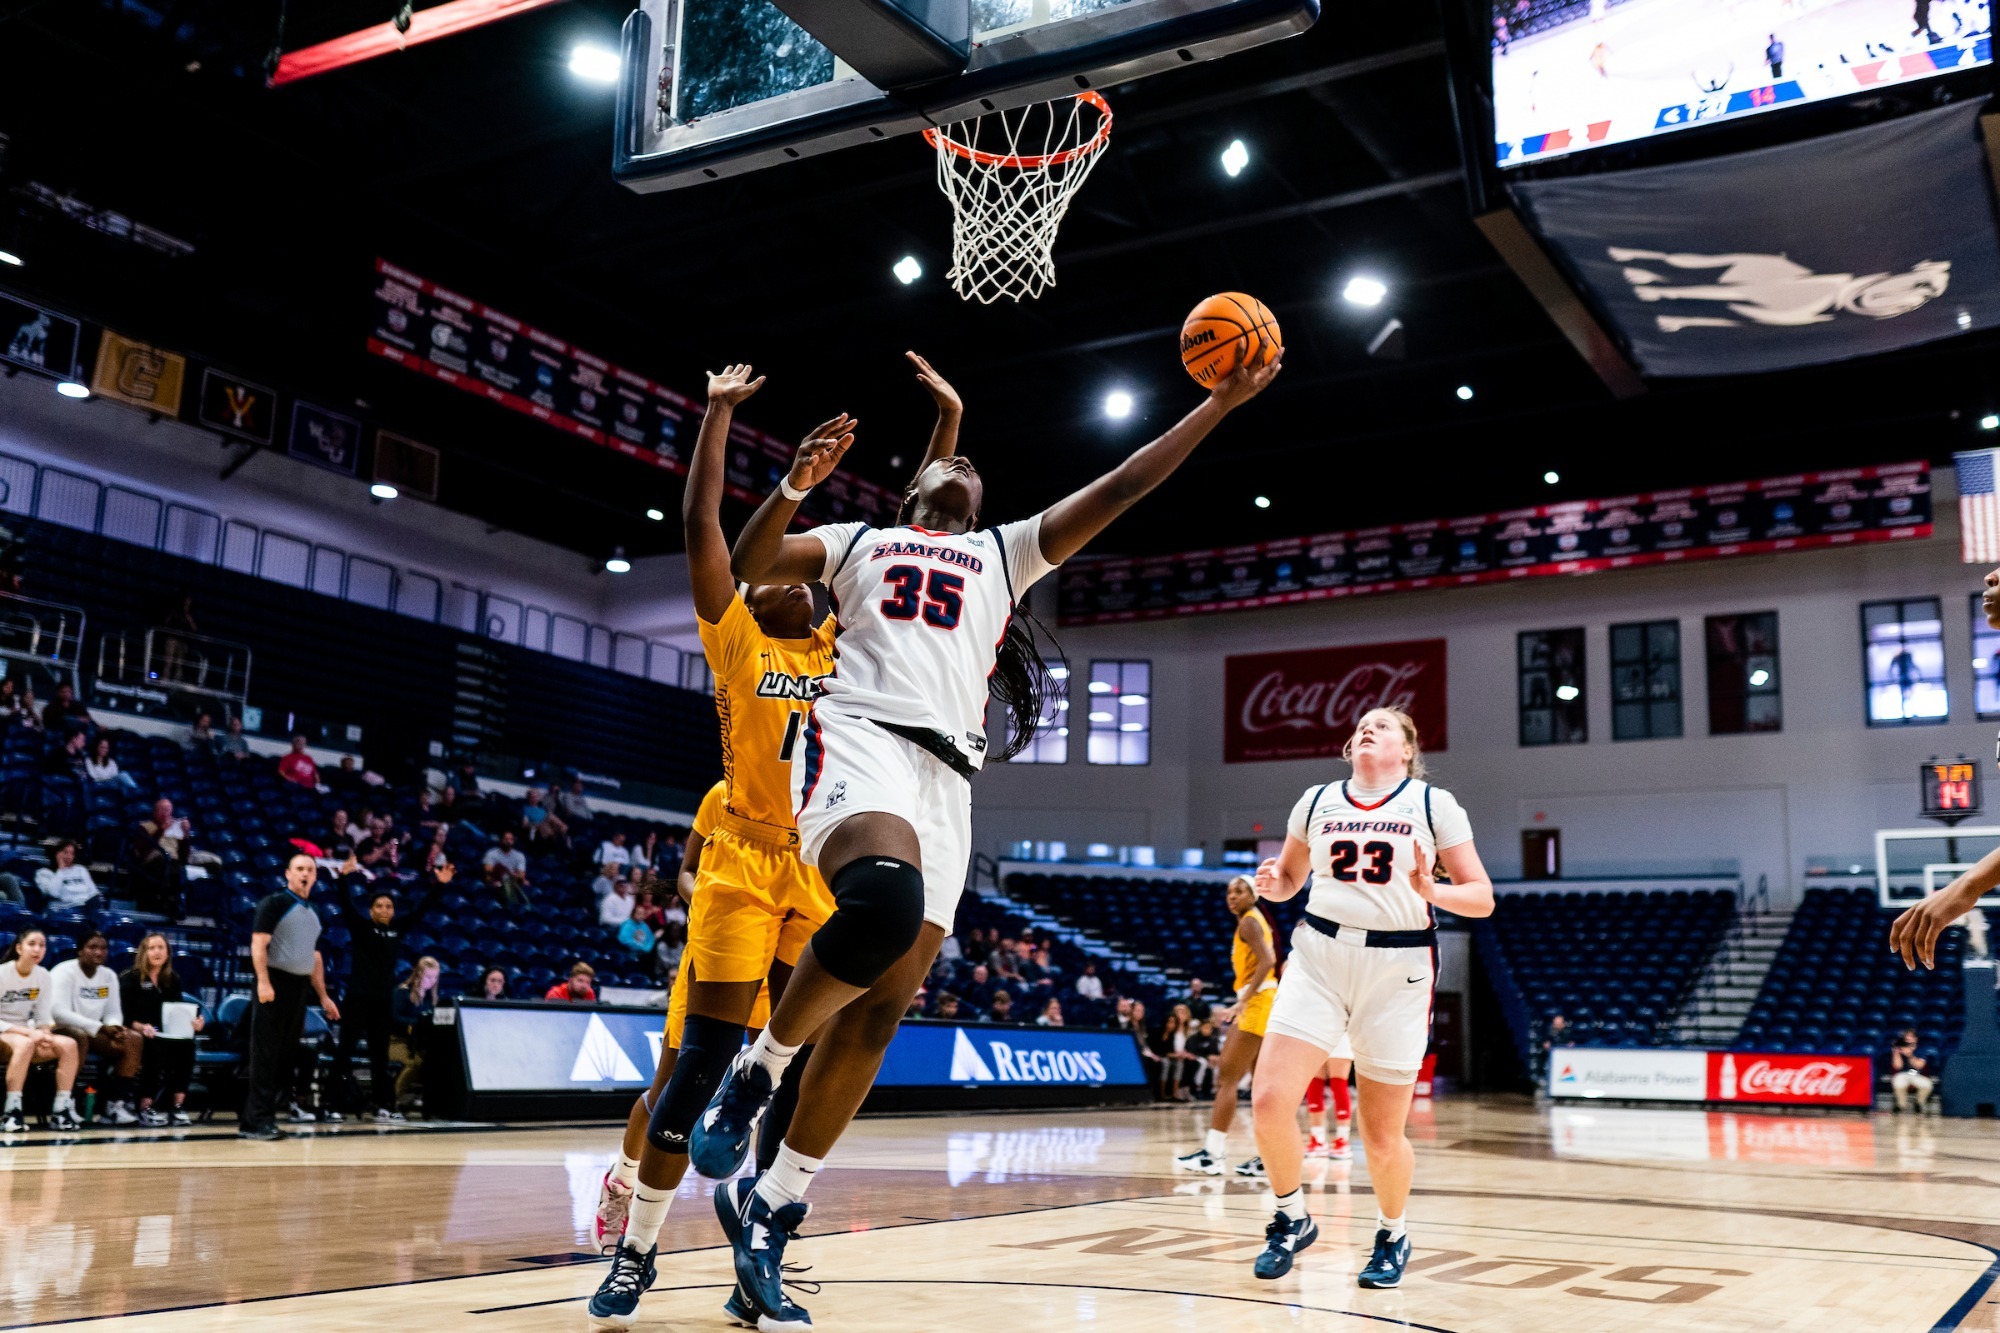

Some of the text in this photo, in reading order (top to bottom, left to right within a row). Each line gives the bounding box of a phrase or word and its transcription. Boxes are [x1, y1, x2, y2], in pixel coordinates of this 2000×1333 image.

[870, 541, 983, 575] SAMFORD
[880, 564, 965, 631] 35
[756, 671, 829, 701] UNC
[1940, 781, 1970, 809] 14
[1321, 821, 1413, 836] SAMFORD
[1330, 840, 1394, 885] 23
[1584, 1070, 1699, 1086] Alabama Power
[1741, 1060, 1853, 1096] Coca-Cola
